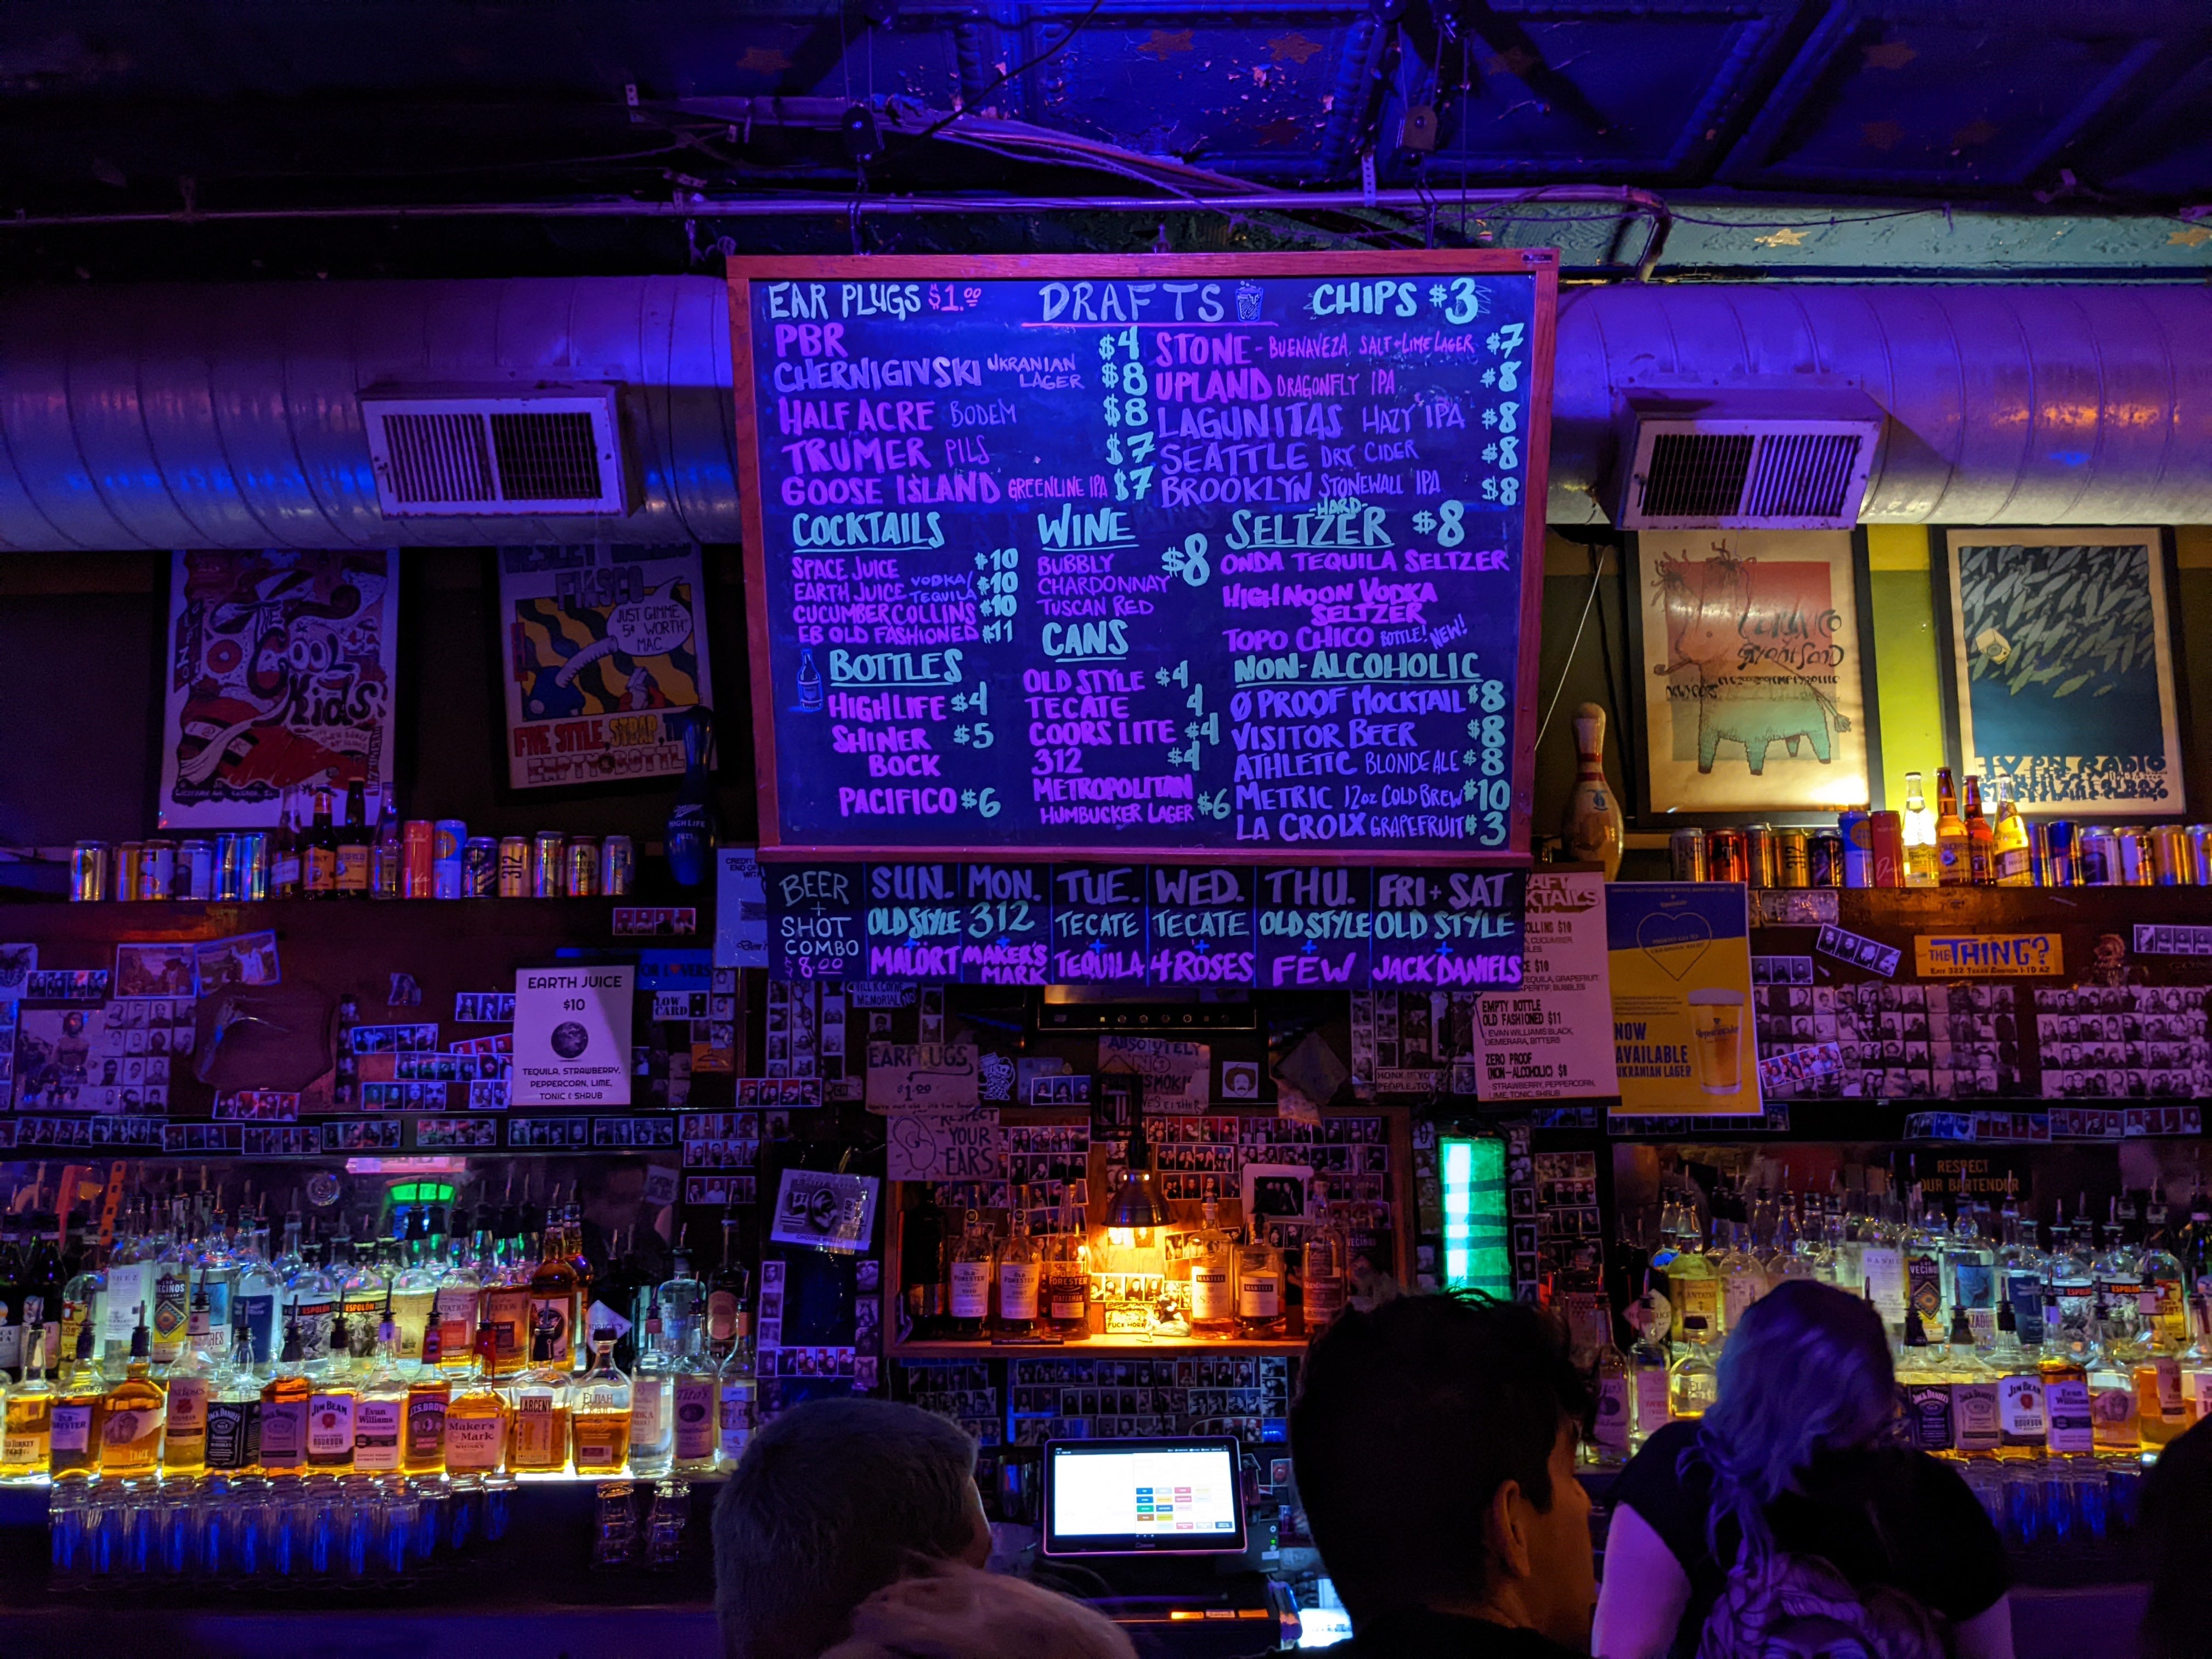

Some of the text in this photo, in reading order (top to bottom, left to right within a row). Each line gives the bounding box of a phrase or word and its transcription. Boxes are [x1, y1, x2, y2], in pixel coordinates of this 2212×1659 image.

[769, 281, 828, 319] EAR
[843, 284, 921, 321] PLUGS
[1039, 281, 1224, 321] DRAFTS
[1312, 277, 1478, 324] CHIPS $3
[775, 323, 848, 358] PBR
[1269, 336, 1348, 359] BUENAVEZA
[1434, 331, 1475, 353] LAGER
[774, 353, 1075, 392] CHERNIGIVSKI UKRANIAN
[1156, 367, 1395, 403] UPLAND DRAGONFLY IPA
[778, 396, 1017, 436] HALF ACRE BODEM
[1158, 402, 1416, 440] LAGUNITAS HAZY
[781, 435, 991, 475] TRUMER PILS
[1161, 437, 1520, 477] SEATTLE DRY CIDER $8
[781, 471, 1085, 506] GOOSE ISLAND GREENLINE
[1161, 471, 1403, 508] BROOKLYN STONEWALL
[793, 511, 945, 549] COCKTAILS
[1038, 503, 1136, 548] WINE
[1226, 506, 1394, 550] SELTZER
[792, 548, 1018, 580] SPACE JUICE $10
[1038, 554, 1114, 577] BUBBLY
[1220, 551, 1397, 574] ONDA TEQUILA
[556, 566, 644, 611] FIASCO
[794, 582, 850, 603] EARTH
[1038, 574, 1170, 597] CHARDONNAY
[1222, 578, 1438, 609] HIGH NOON VODKA
[617, 605, 680, 623] JUST GIMME
[794, 602, 976, 627] CUCUMBER COLLINS
[1037, 596, 1154, 617] TUSCAN RED
[637, 638, 661, 652] MAC
[828, 620, 1013, 645] OLD FASHIONED $11
[1043, 619, 1129, 657] CANS
[1222, 614, 1468, 652] TOPO CHICO NEW!
[830, 648, 963, 683] BOTTLES
[1234, 651, 1481, 679] NON-ALCOHOLIC
[1025, 696, 1130, 719] TECATE
[1258, 685, 1465, 718] PROOF MOCKTAIL
[833, 725, 932, 754] SHINER
[1029, 719, 1177, 746] COORS LITE
[1231, 718, 1418, 751] VISITOR BEER
[869, 754, 940, 777] BOCK
[1031, 748, 1082, 775] 312
[1234, 750, 1459, 782] ATHLETIC BLONDE ALE
[1034, 774, 1193, 802] METROPOLITAN
[1236, 782, 1462, 810] METRIC COLD BREW
[839, 787, 957, 818] PACIFICO
[1040, 805, 1142, 825] HUMBUCKER
[1279, 812, 1464, 842] CROIX GRAPEFRUIT
[502, 855, 522, 878] 312
[781, 916, 851, 938] SHOT
[1558, 920, 1572, 933] $10
[786, 940, 859, 957] COMBO
[962, 941, 1047, 968] MAKER'S
[528, 976, 622, 989] EARTH JUICE
[981, 966, 1048, 985] MARK
[1273, 952, 1356, 986] FEW
[1373, 954, 1522, 985] JACK DANIELS
[563, 999, 585, 1011] $10
[655, 1007, 687, 1015] CARD
[656, 997, 680, 1006] LOW
[857, 995, 900, 1006] MEMORIAL
[1482, 1000, 1541, 1012] EMPTY BOTTLE
[1483, 1011, 1561, 1026] OLD FASHIONED $11
[1615, 1023, 1646, 1040] NOW
[1486, 1053, 1532, 1065] ZERO PROOF
[1616, 1045, 1688, 1063] AVAILABLE
[949, 1127, 991, 1146] YOUR
[946, 1147, 993, 1175] EARS
[1949, 1178, 2019, 1192] BARTENDR
[1049, 1276, 1088, 1285] FORESTER
[312, 1401, 347, 1417] JIM BEAM
[359, 1415, 393, 1424] Williams
